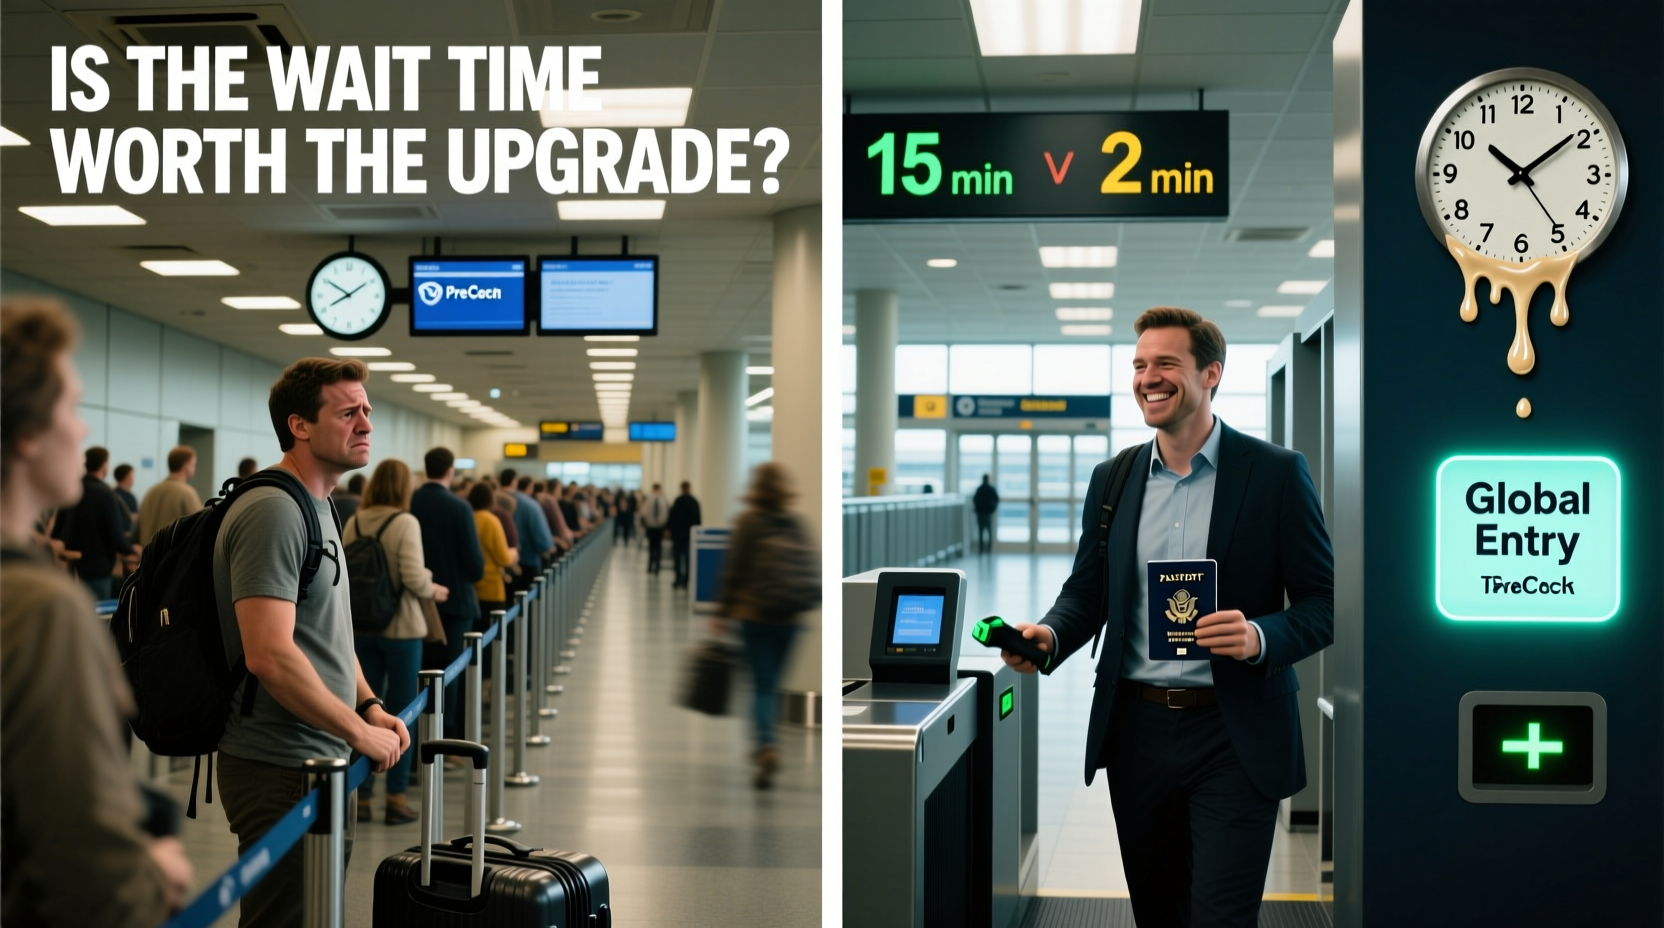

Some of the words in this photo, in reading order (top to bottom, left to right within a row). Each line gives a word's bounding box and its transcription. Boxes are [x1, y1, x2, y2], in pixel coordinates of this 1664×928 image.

[1480, 104, 1496, 124] 11
[1511, 94, 1534, 115] 12
[1555, 104, 1562, 124] 1
[1453, 130, 1475, 150] 10
[1576, 129, 1591, 149] 2
[867, 132, 942, 196] 15
[951, 162, 1013, 195] min
[1100, 130, 1142, 194] 2
[1151, 161, 1214, 194] min
[1443, 163, 1458, 184] 9
[1586, 164, 1601, 185] 3
[1454, 199, 1469, 220] 8
[1575, 200, 1590, 220] 4
[1480, 222, 1495, 243] 7
[1550, 223, 1565, 244] 5
[1513, 233, 1529, 254] 6
[1465, 481, 1590, 515] Global
[1476, 523, 1580, 566] Entry
